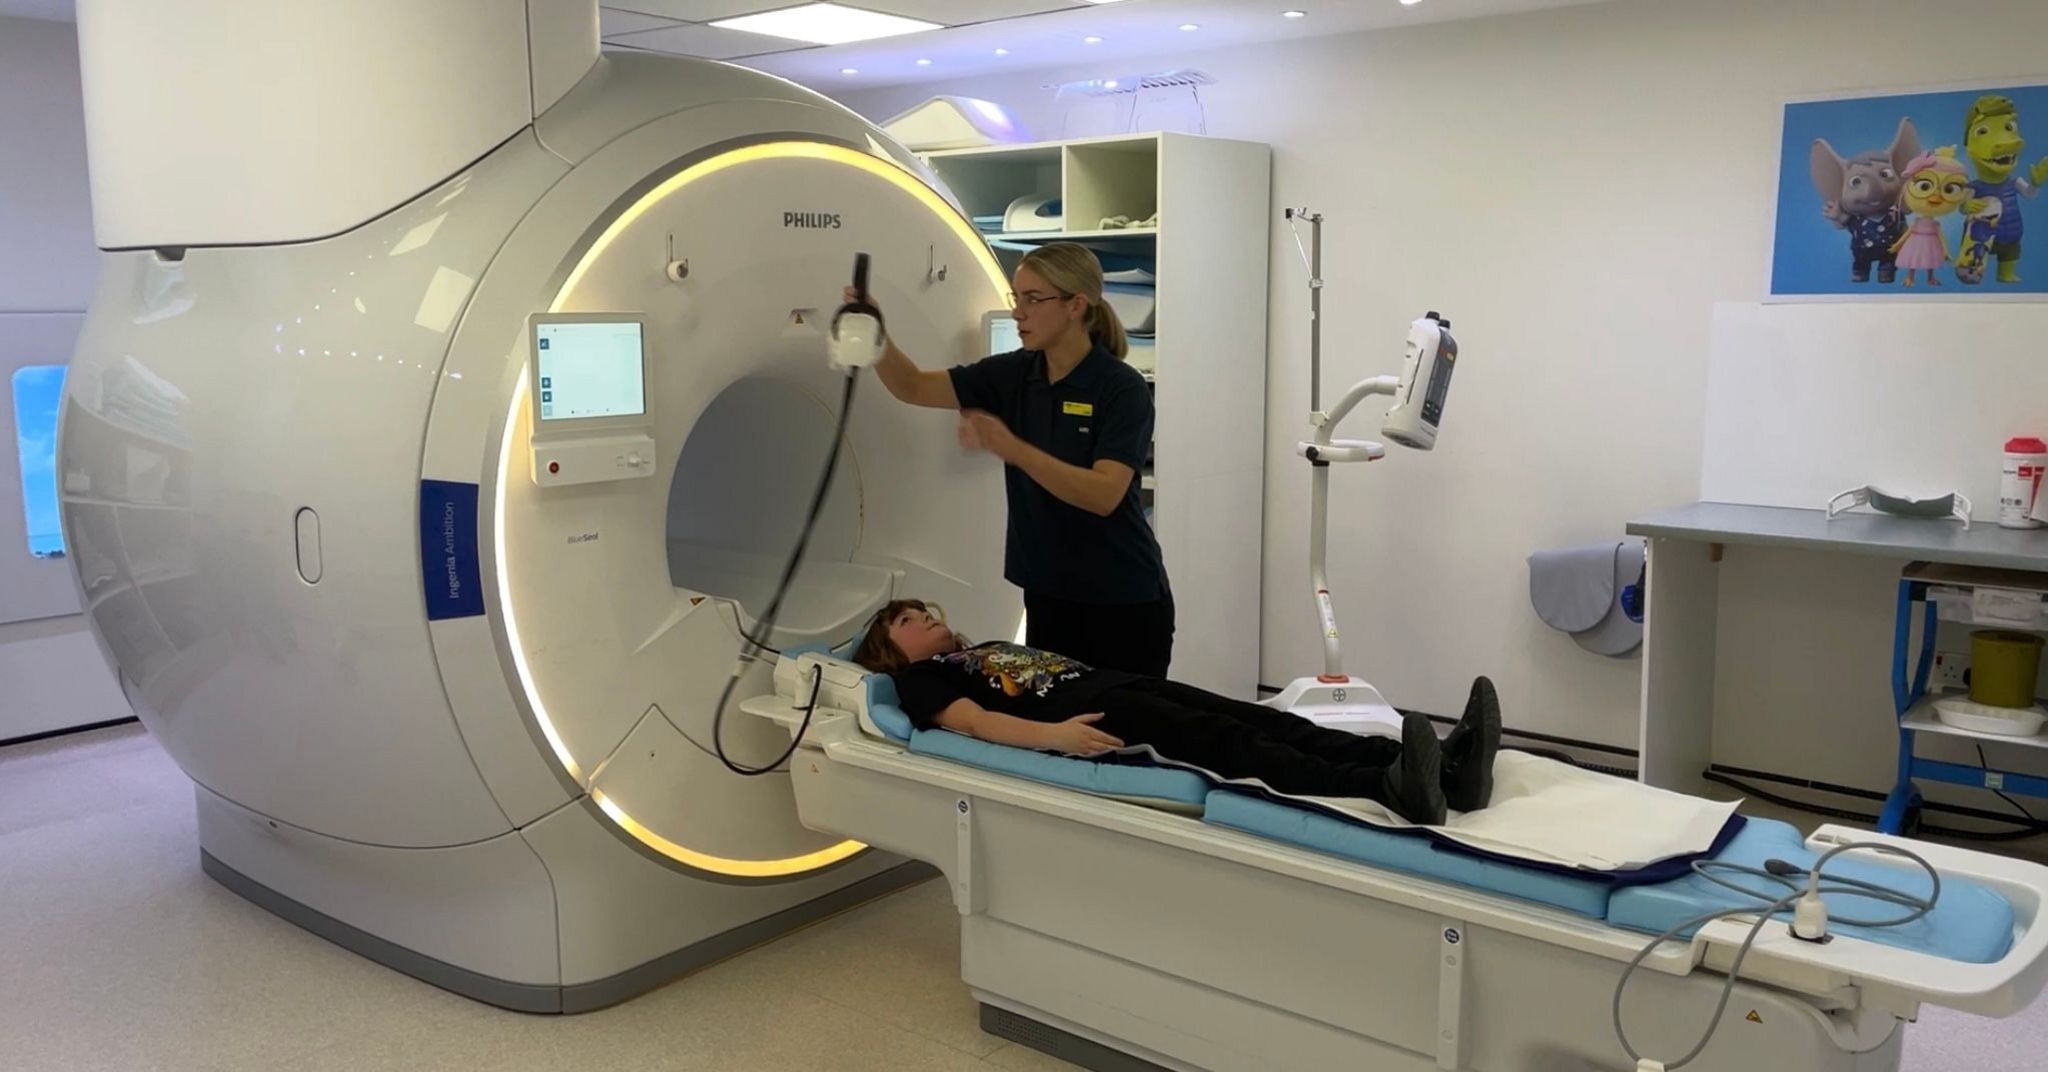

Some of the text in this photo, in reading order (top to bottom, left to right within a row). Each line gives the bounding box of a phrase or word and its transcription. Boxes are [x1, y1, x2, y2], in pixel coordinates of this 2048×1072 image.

[784, 211, 841, 229] PHILIPS
[443, 501, 461, 599] Ingenia Ambition
